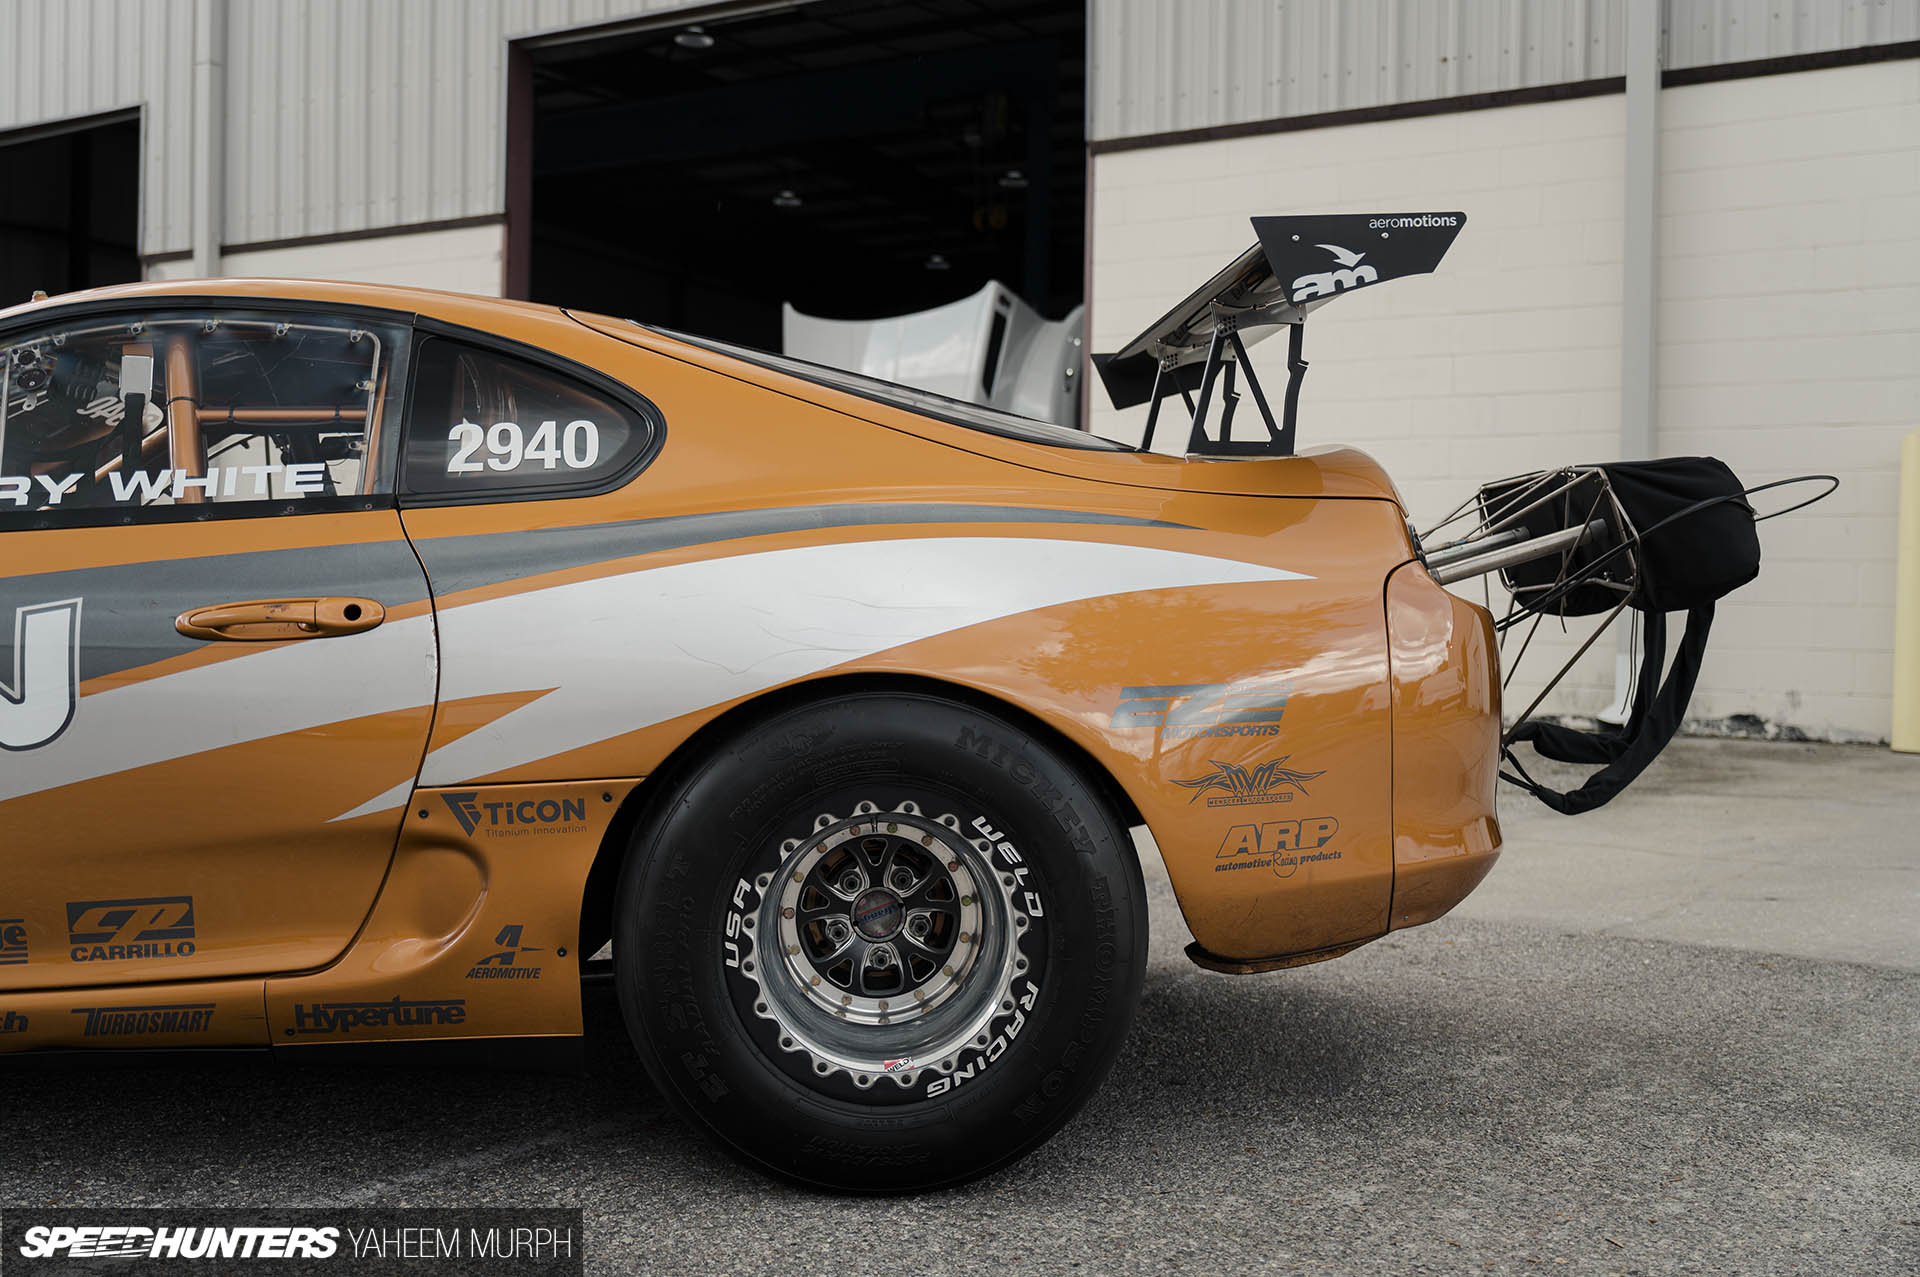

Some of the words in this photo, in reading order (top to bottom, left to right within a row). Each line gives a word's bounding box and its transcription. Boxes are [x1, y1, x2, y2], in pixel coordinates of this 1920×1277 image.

[1368, 214, 1457, 229] aeromotions
[447, 419, 600, 473] 2940
[108, 462, 326, 501] WHITE
[1160, 725, 1281, 739] MOTORSPORTS
[485, 827, 530, 839] Titanium
[533, 824, 588, 836] Innovation
[1215, 816, 1340, 859] ARP
[971, 815, 1044, 918] WELD
[1215, 857, 1272, 873] automotive
[1300, 849, 1342, 865] products
[724, 877, 752, 969] USA
[70, 941, 196, 963] CARRILLO
[464, 966, 542, 980] AEROMOTIVE
[71, 1003, 217, 1037] TURBOSMART
[294, 994, 467, 1034] Hypertune
[926, 980, 1040, 1099] RACING
